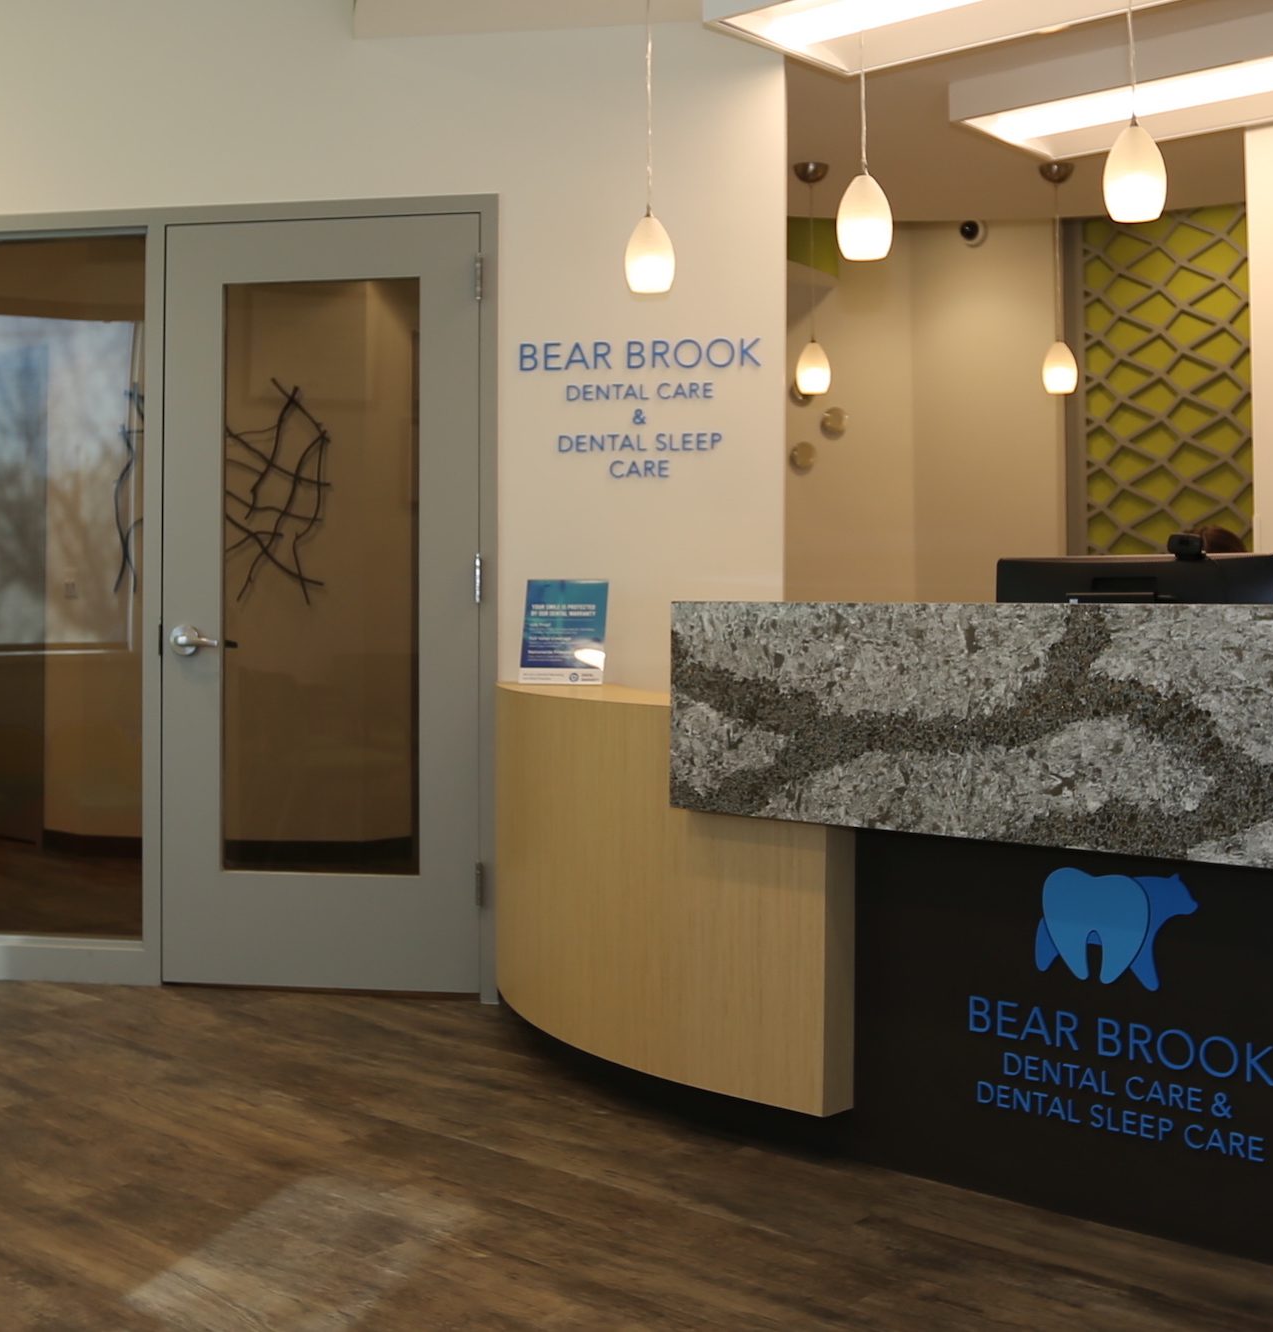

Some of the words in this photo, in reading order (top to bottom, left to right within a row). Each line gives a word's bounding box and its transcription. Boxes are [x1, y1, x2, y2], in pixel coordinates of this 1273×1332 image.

[518, 341, 613, 372] BEAR
[625, 337, 762, 370] BROOK
[565, 383, 650, 402] DENTAL
[656, 382, 714, 400] CARE
[632, 408, 647, 426] &
[557, 434, 647, 453] DENTAL
[655, 432, 723, 451] SLEEP
[608, 459, 670, 479] CARE
[968, 995, 1079, 1051] BEAR
[1003, 1051, 1116, 1096] DENTAL
[1125, 1075, 1203, 1113] CARE
[1210, 1091, 1233, 1120] &
[976, 1080, 1081, 1124] DENTAL
[1089, 1103, 1174, 1141] SLEEP
[1184, 1124, 1265, 1163] CARE
